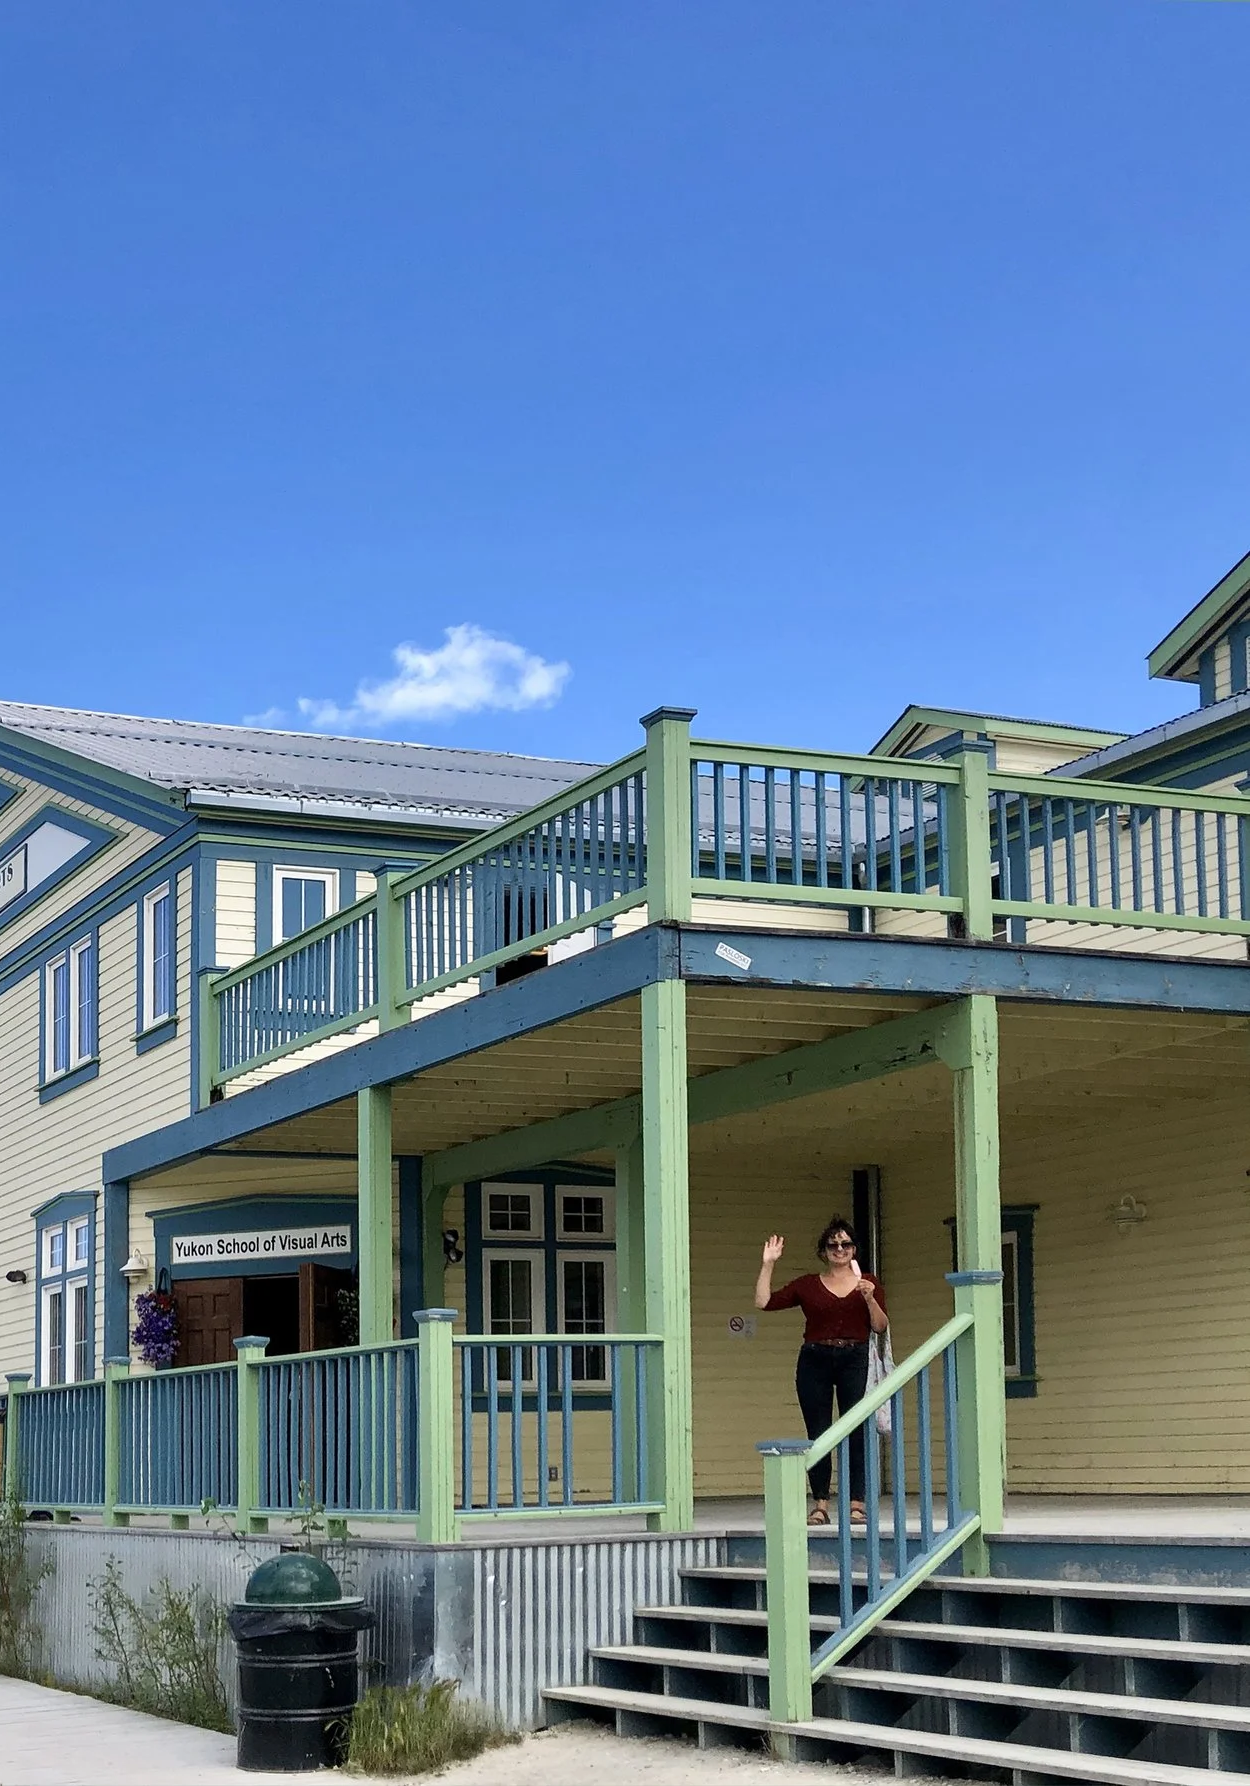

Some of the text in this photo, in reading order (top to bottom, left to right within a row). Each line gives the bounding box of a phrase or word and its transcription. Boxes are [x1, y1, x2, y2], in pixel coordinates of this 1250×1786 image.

[175, 1231, 347, 1257] Yukon School of Visual Arts
